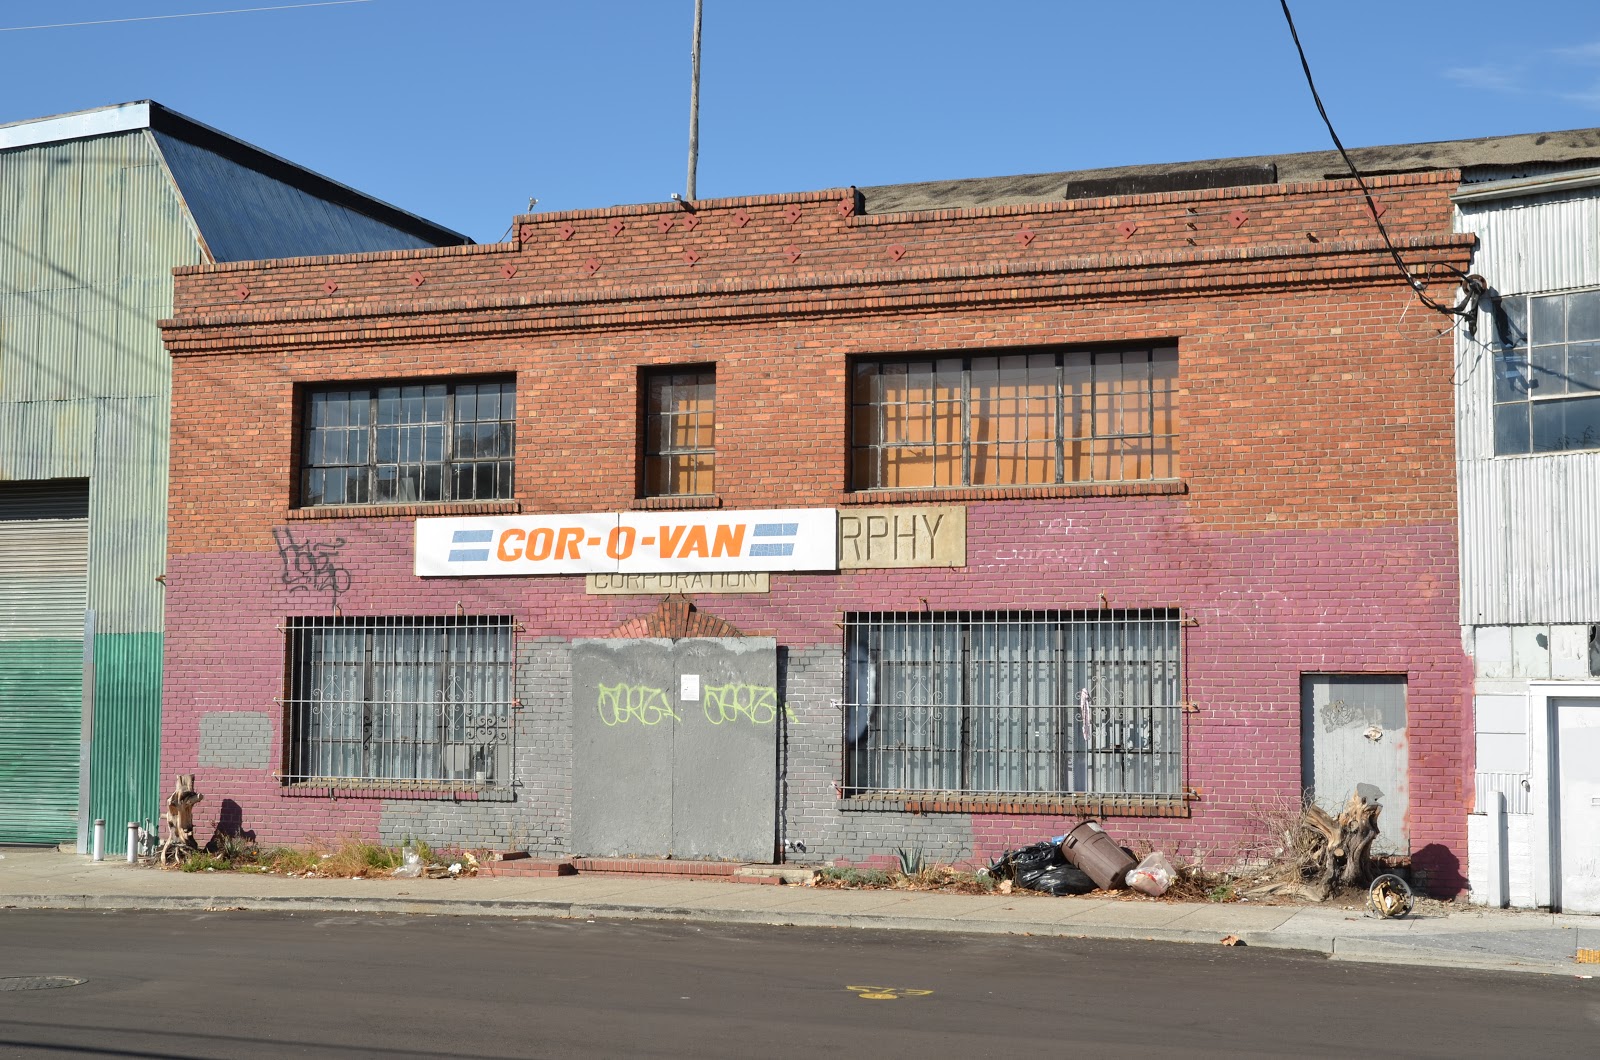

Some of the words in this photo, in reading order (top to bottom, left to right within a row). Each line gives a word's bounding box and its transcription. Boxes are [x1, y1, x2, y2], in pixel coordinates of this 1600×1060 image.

[497, 524, 746, 561] COR-O-VAN
[840, 514, 944, 561] RPHY
[594, 572, 758, 589] CORPORATION
